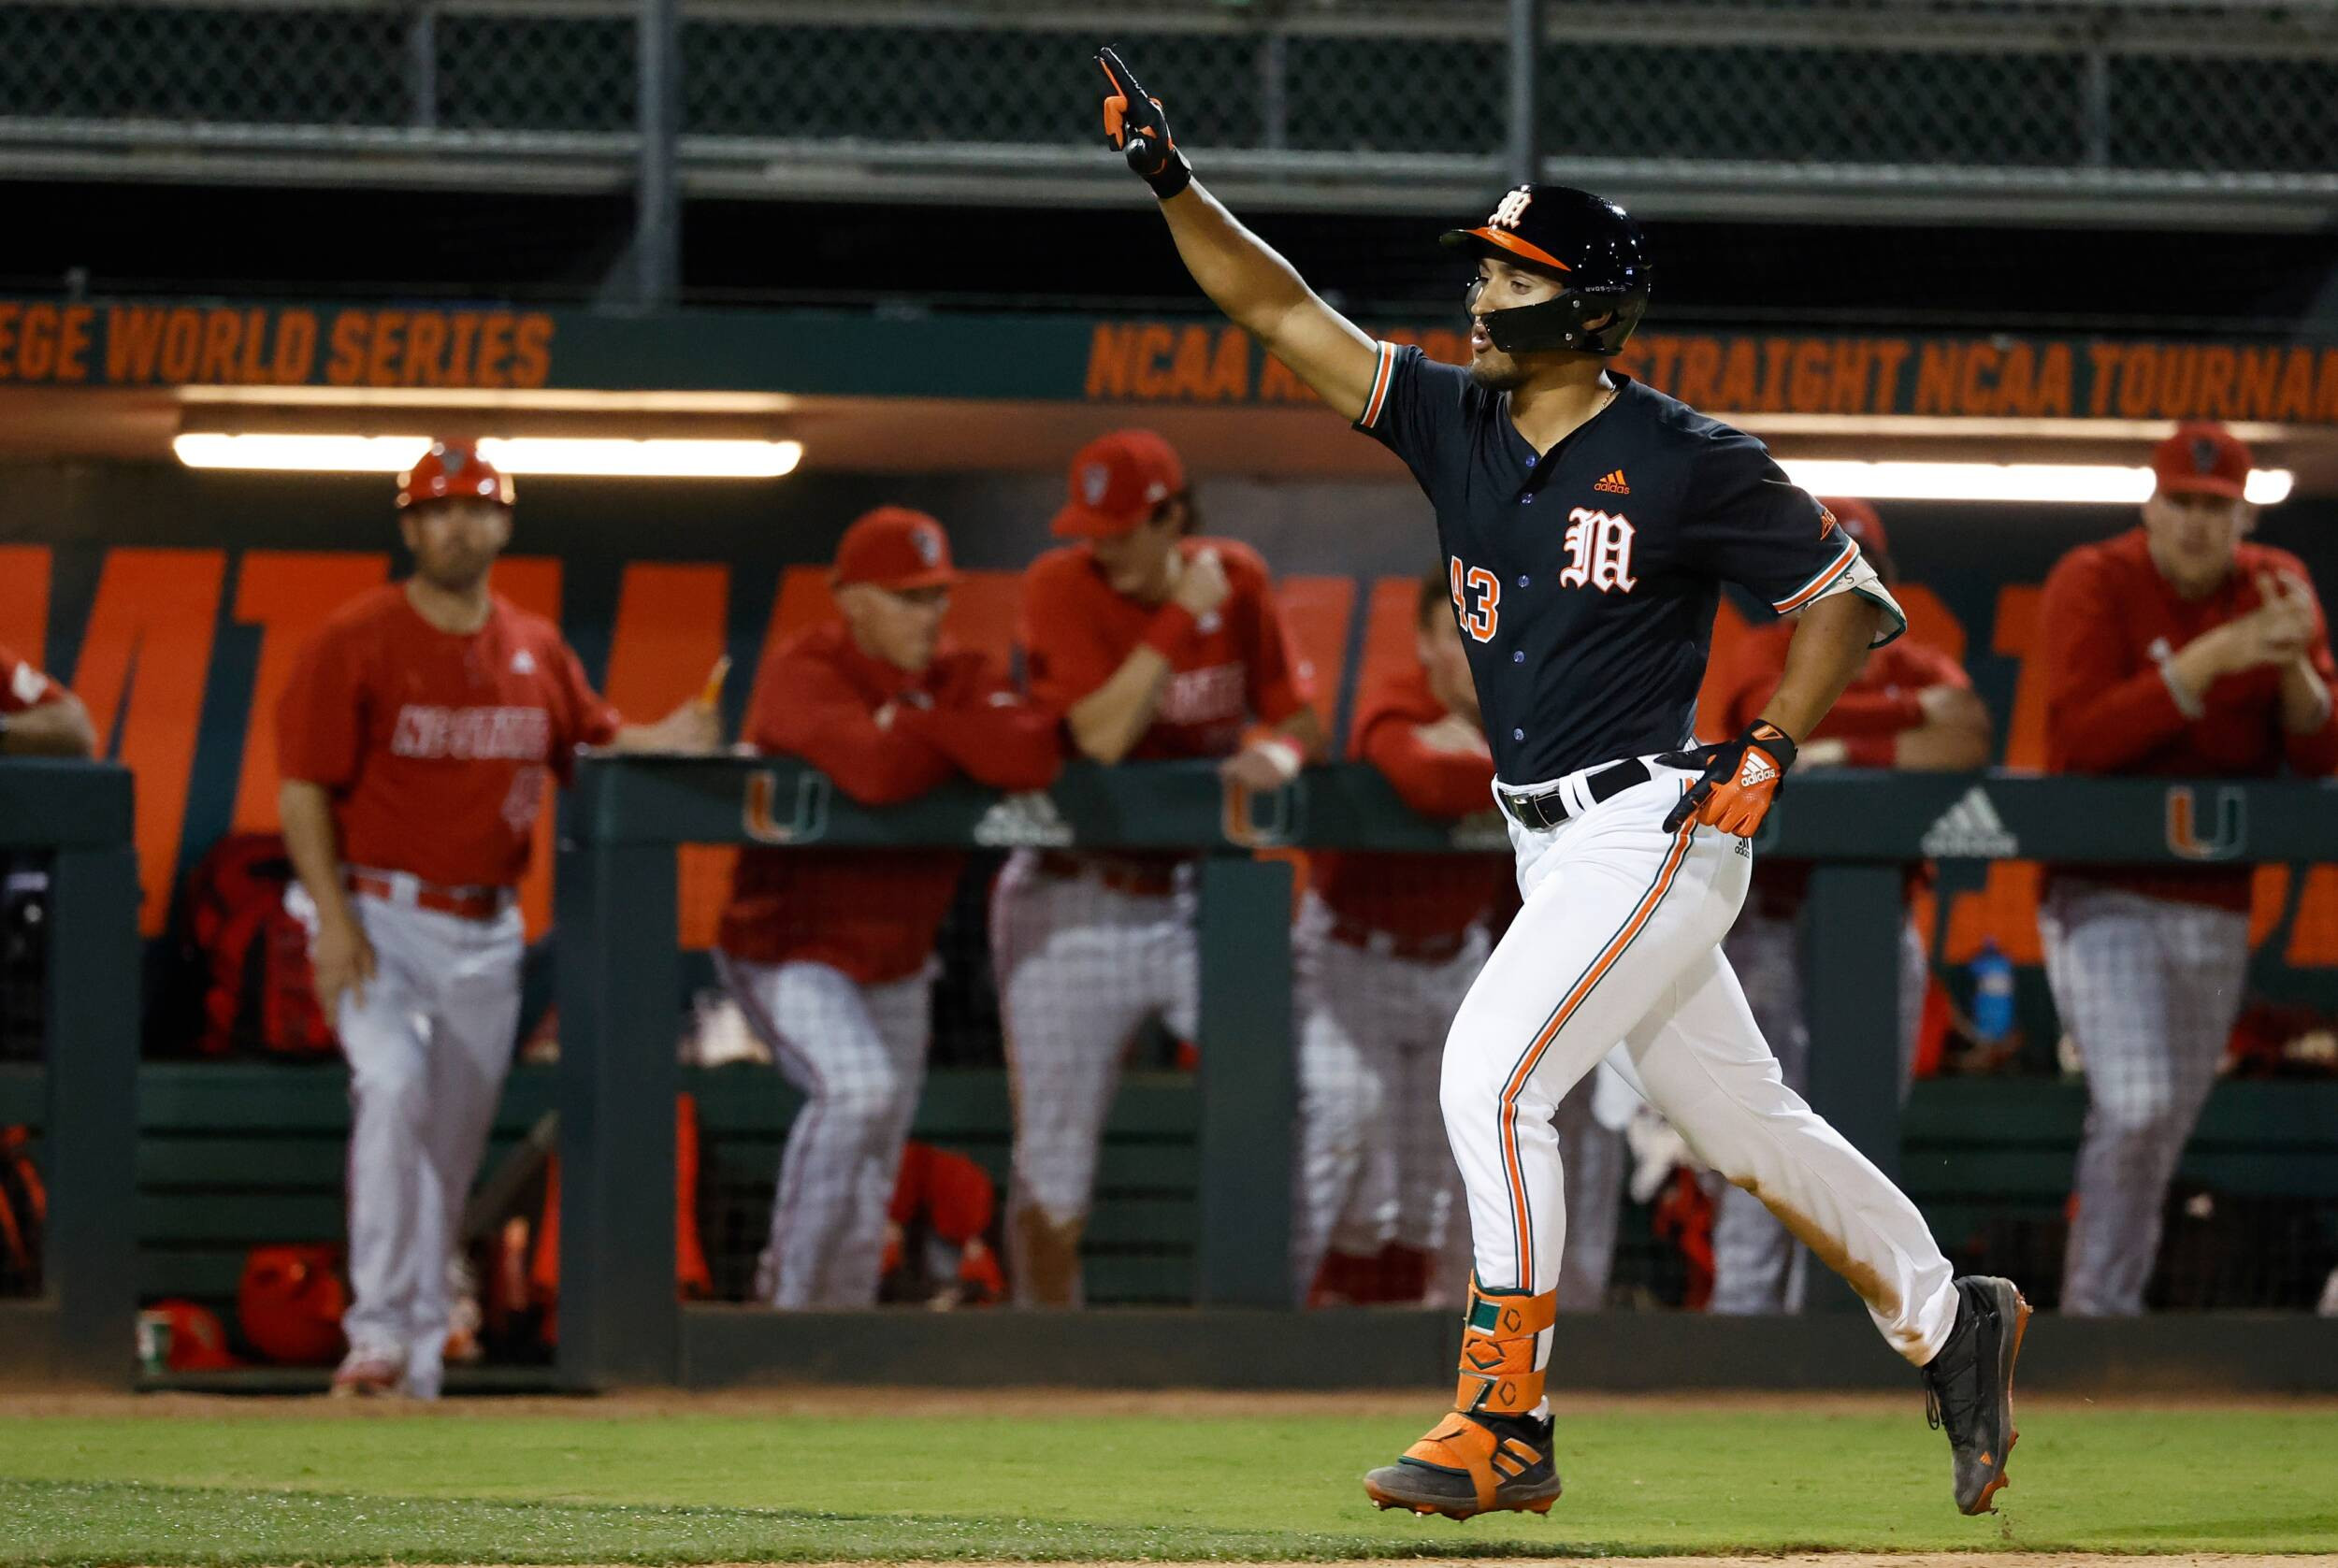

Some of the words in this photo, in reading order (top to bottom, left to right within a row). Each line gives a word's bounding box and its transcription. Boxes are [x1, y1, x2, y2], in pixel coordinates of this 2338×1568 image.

[106, 304, 318, 384] WORLD
[325, 309, 556, 388] SERIES
[1084, 322, 1250, 400] NCAA
[1913, 339, 2073, 417] NCAA
[1594, 481, 1630, 495] adidas
[1560, 506, 1638, 594] M
[1450, 554, 1500, 643] 43
[1740, 767, 1776, 787] adidas
